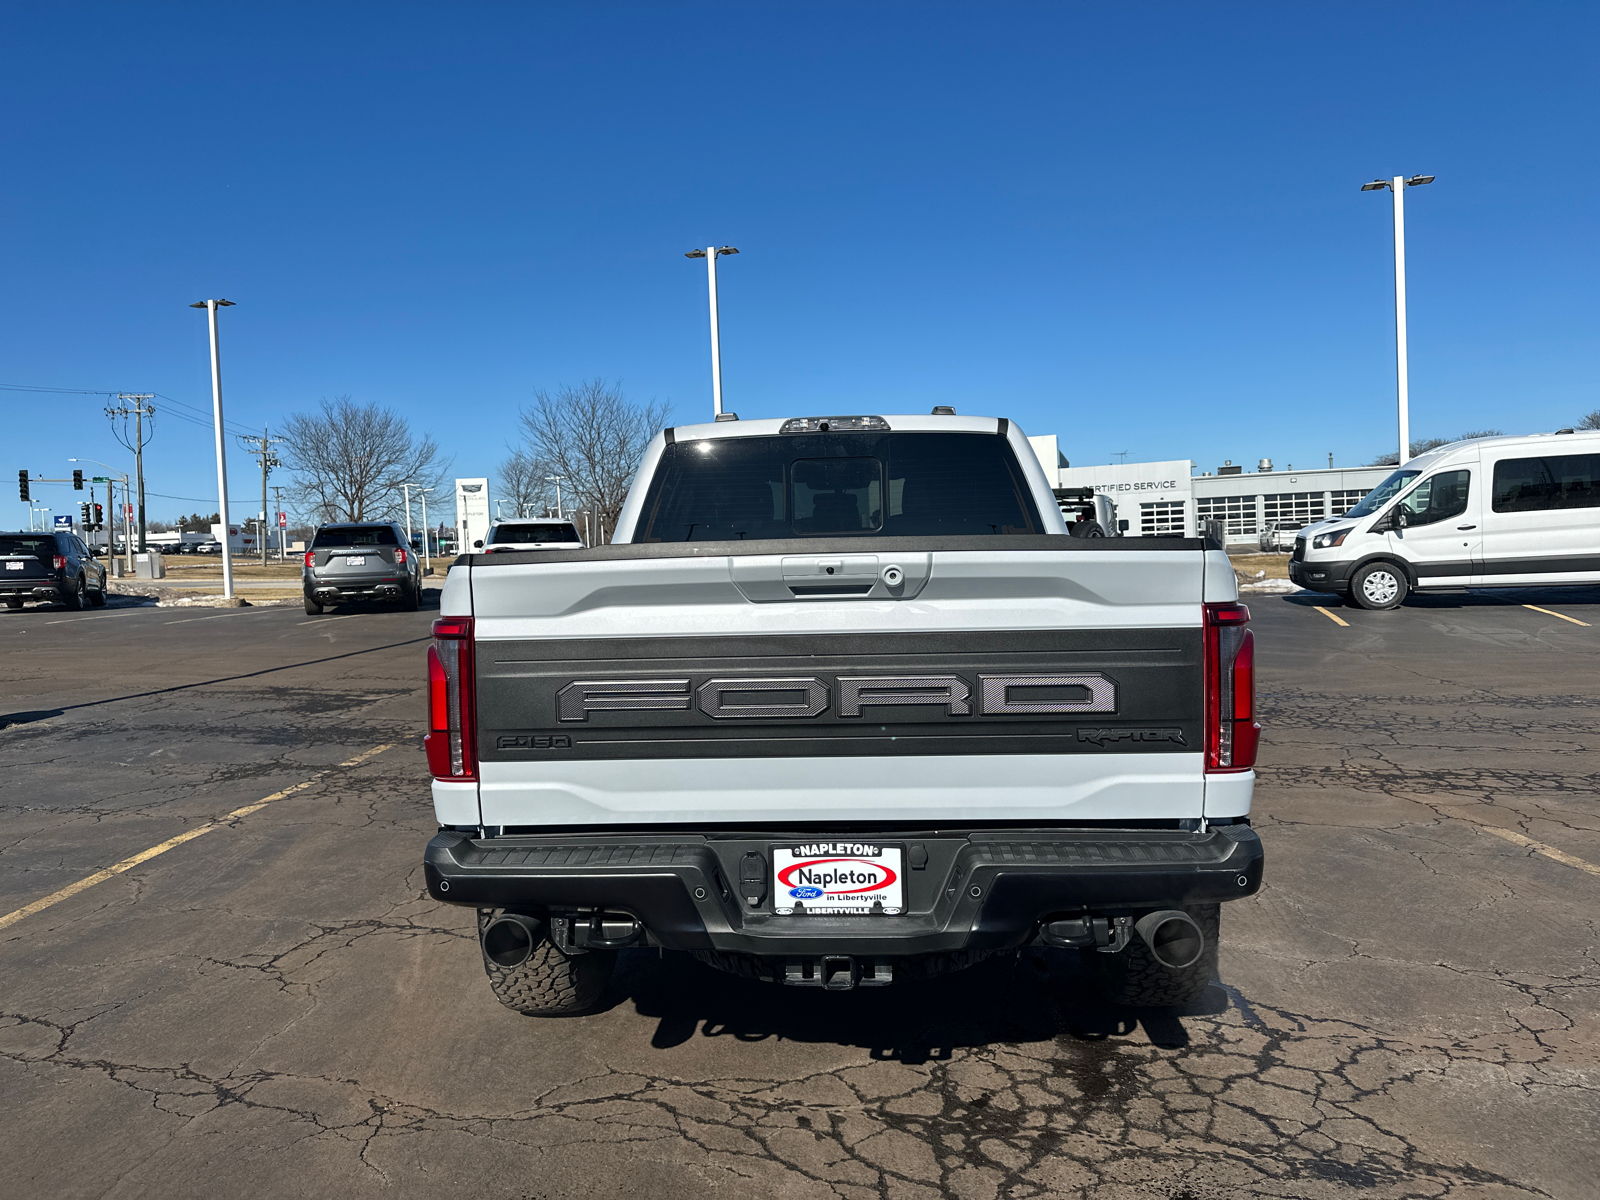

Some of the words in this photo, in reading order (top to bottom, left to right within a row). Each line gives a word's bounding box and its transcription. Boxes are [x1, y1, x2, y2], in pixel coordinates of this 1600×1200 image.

[1084, 483, 1131, 493] RTIFIED
[1134, 481, 1176, 491] SERVICE
[556, 673, 1119, 723] FORD
[1077, 726, 1187, 747] RAPTOR
[800, 843, 874, 857] NAPLETON
[799, 868, 877, 888] Napleton
[795, 888, 818, 898] Ford
[837, 893, 888, 902] Libertyville
